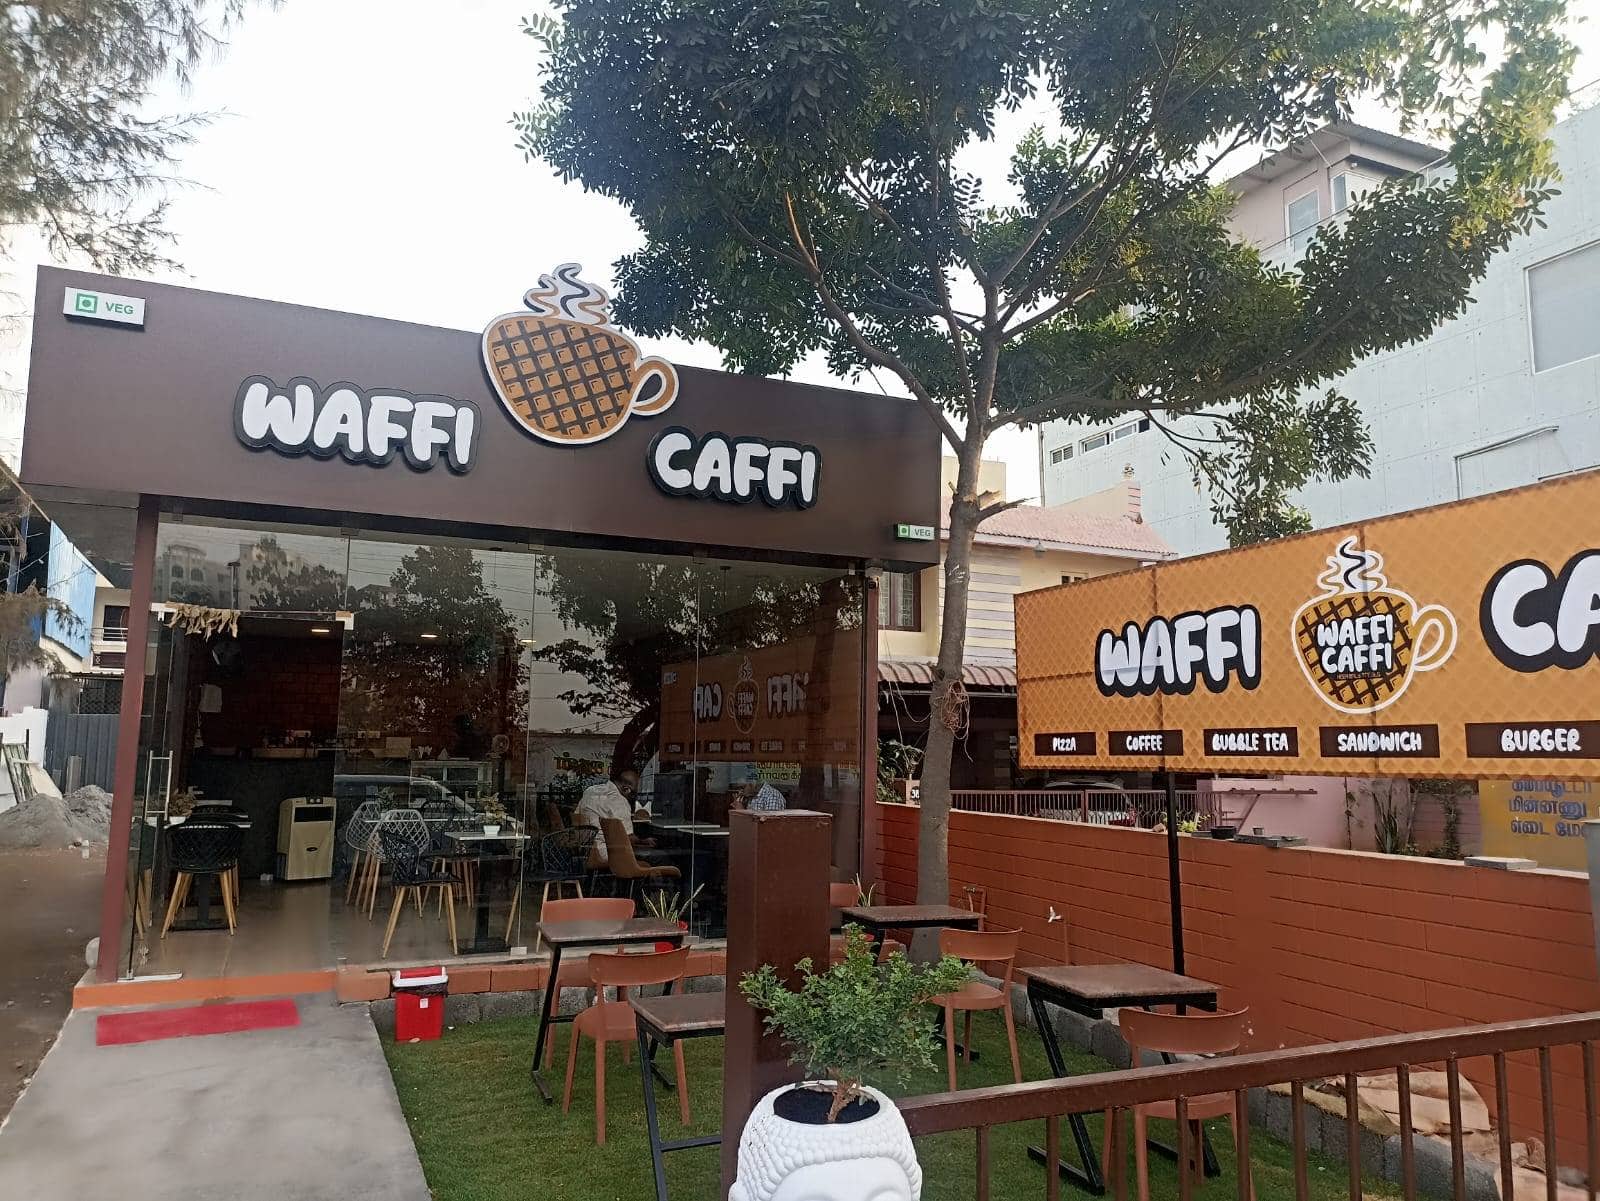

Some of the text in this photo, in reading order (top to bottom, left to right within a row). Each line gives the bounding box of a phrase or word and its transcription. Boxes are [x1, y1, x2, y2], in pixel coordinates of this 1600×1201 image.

[105, 302, 134, 315] VEG
[241, 382, 816, 503] WAFFI CAFFI
[914, 528, 931, 537] VEG
[1317, 614, 1393, 647] WAFFI
[1100, 608, 1257, 687] WAFFI
[1321, 642, 1392, 674] CAFFI
[1052, 737, 1077, 752] PIZZA
[1126, 735, 1163, 751] COFFEE
[1212, 732, 1289, 751] BUBBLE TEA
[1337, 731, 1422, 752] SANDWICH
[1501, 728, 1582, 752] BURGER
